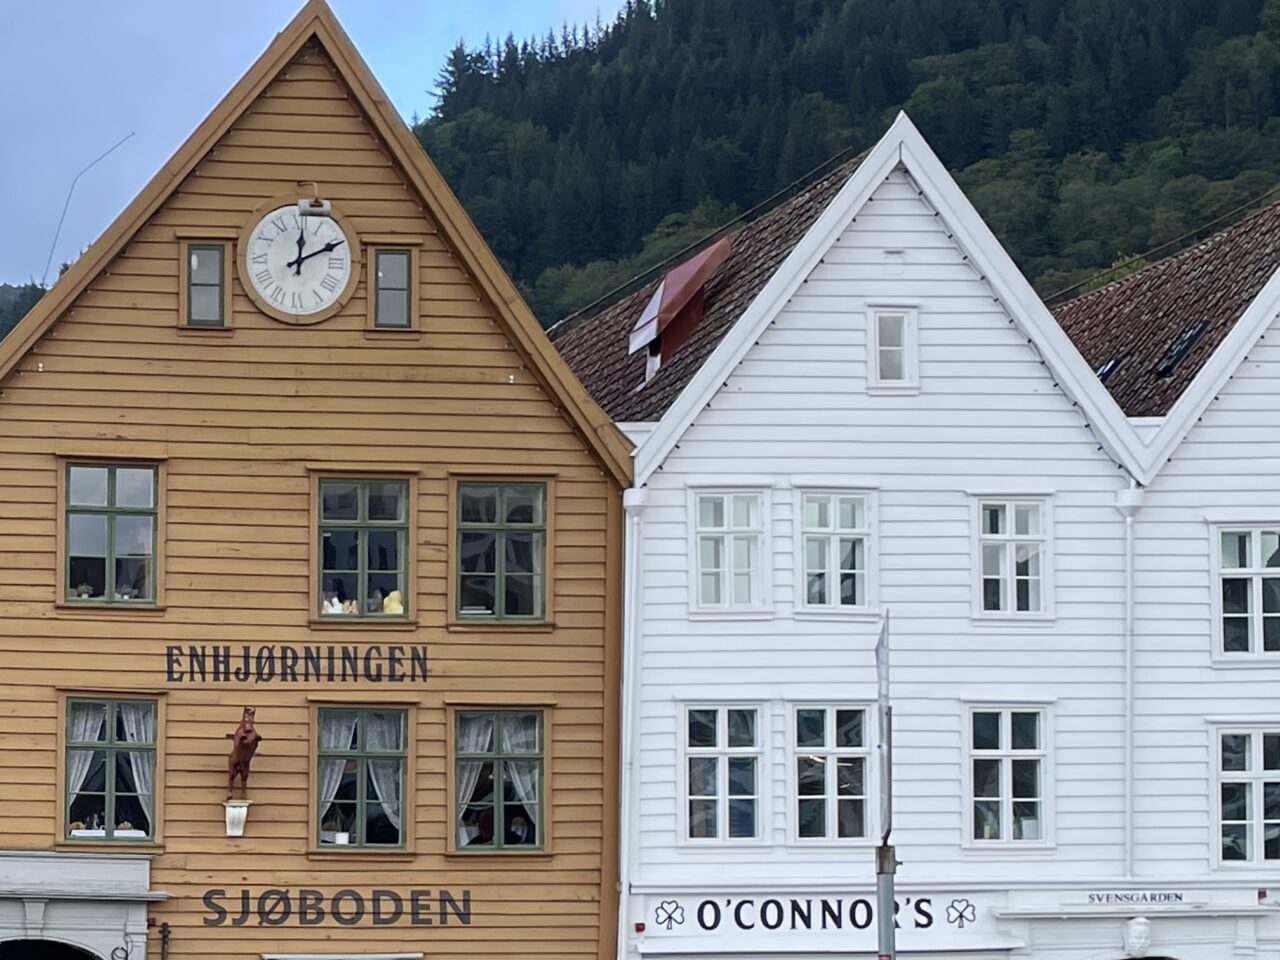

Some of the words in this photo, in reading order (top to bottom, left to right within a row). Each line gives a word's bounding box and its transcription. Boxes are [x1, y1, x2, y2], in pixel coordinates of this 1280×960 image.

[313, 220, 324, 236] I
[328, 257, 344, 270] III
[165, 644, 428, 684] ENHJØRNINGEN
[202, 888, 472, 927] SJØBODEN
[696, 898, 934, 930] O'CONNO'S
